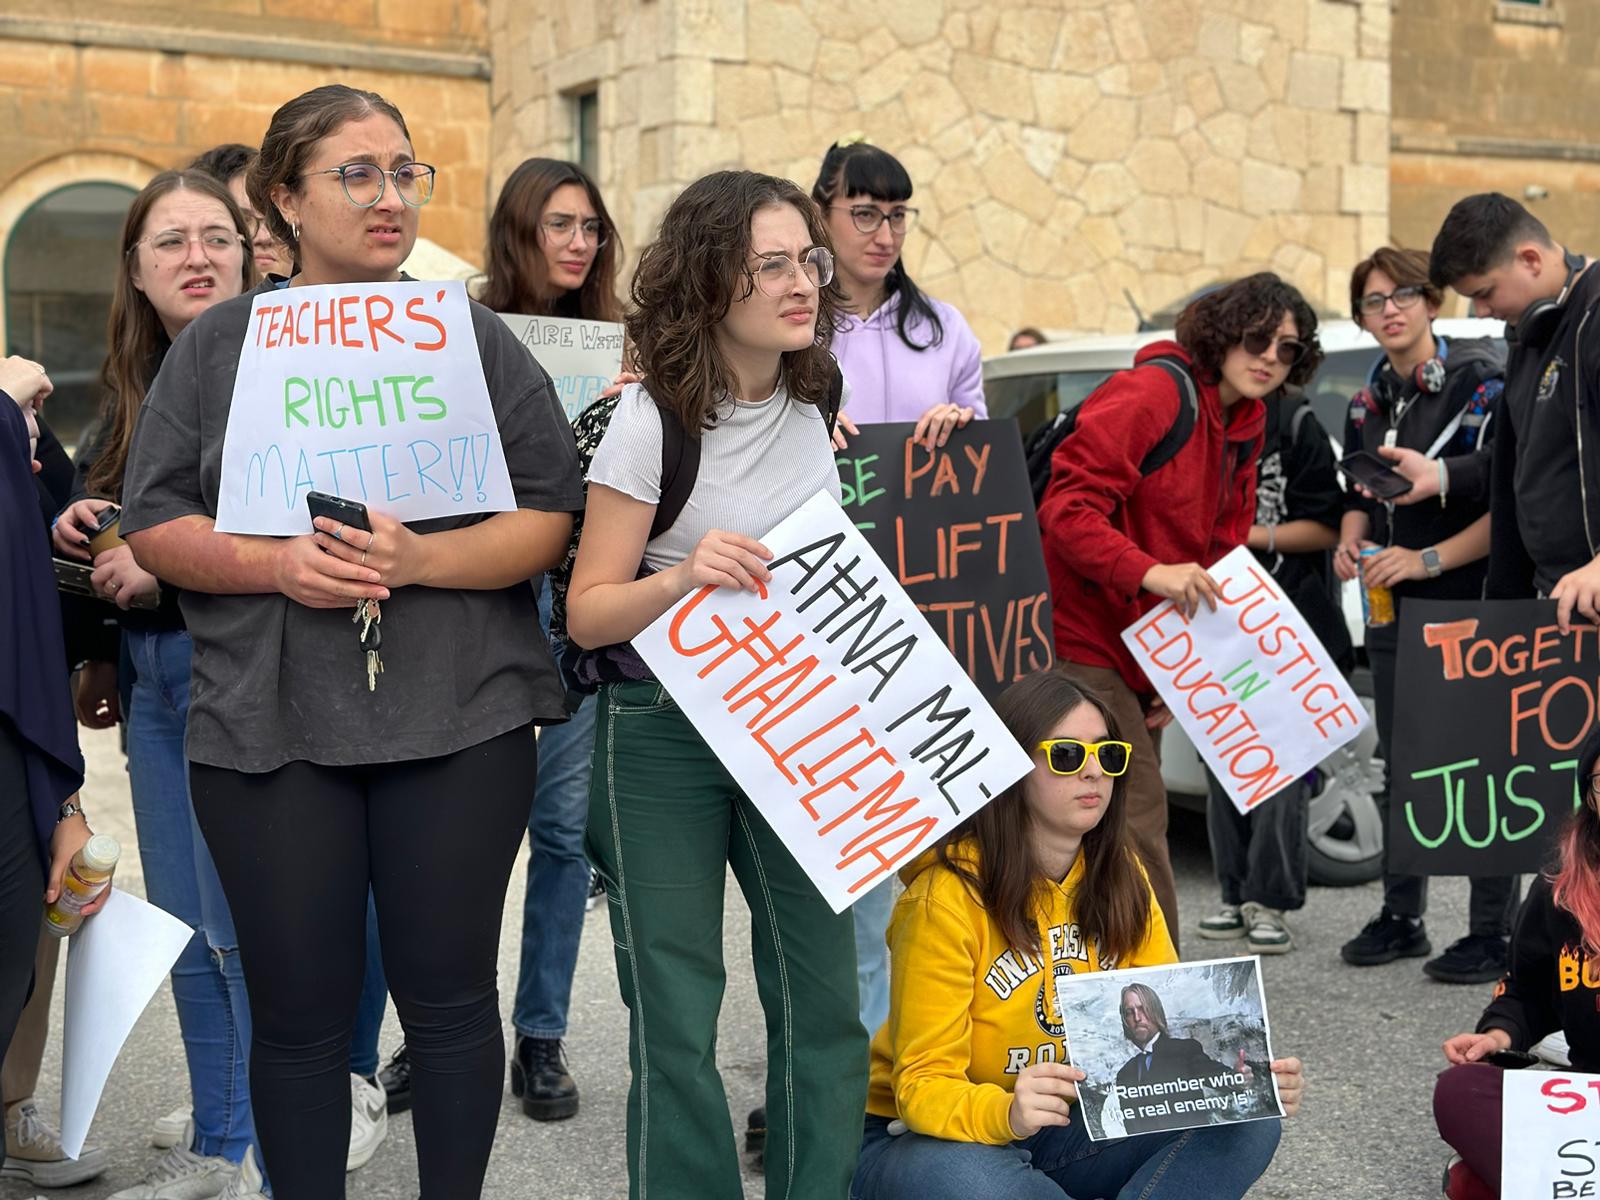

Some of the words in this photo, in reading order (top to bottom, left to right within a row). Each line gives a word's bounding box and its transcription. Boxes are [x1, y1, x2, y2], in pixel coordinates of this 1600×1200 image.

[256, 290, 447, 352] TEACHERS'
[521, 318, 573, 347] ARE
[580, 325, 623, 350] WITH
[284, 375, 447, 429] RIGHTS
[245, 433, 490, 511] MATTER!!
[904, 435, 991, 500] PAY
[895, 512, 1023, 586] LIFT
[1219, 565, 1359, 739] JUSTICE
[1221, 658, 1271, 703] IN
[1423, 618, 1600, 681] TOGET
[1134, 603, 1294, 807] EDUCATION
[1511, 675, 1600, 757] FO
[884, 683, 992, 816] MAL-
[1138, 1100, 1172, 1118] real
[1174, 1094, 1230, 1114] enemy
[1209, 1071, 1245, 1088] who
[1558, 1139, 1600, 1177] S
